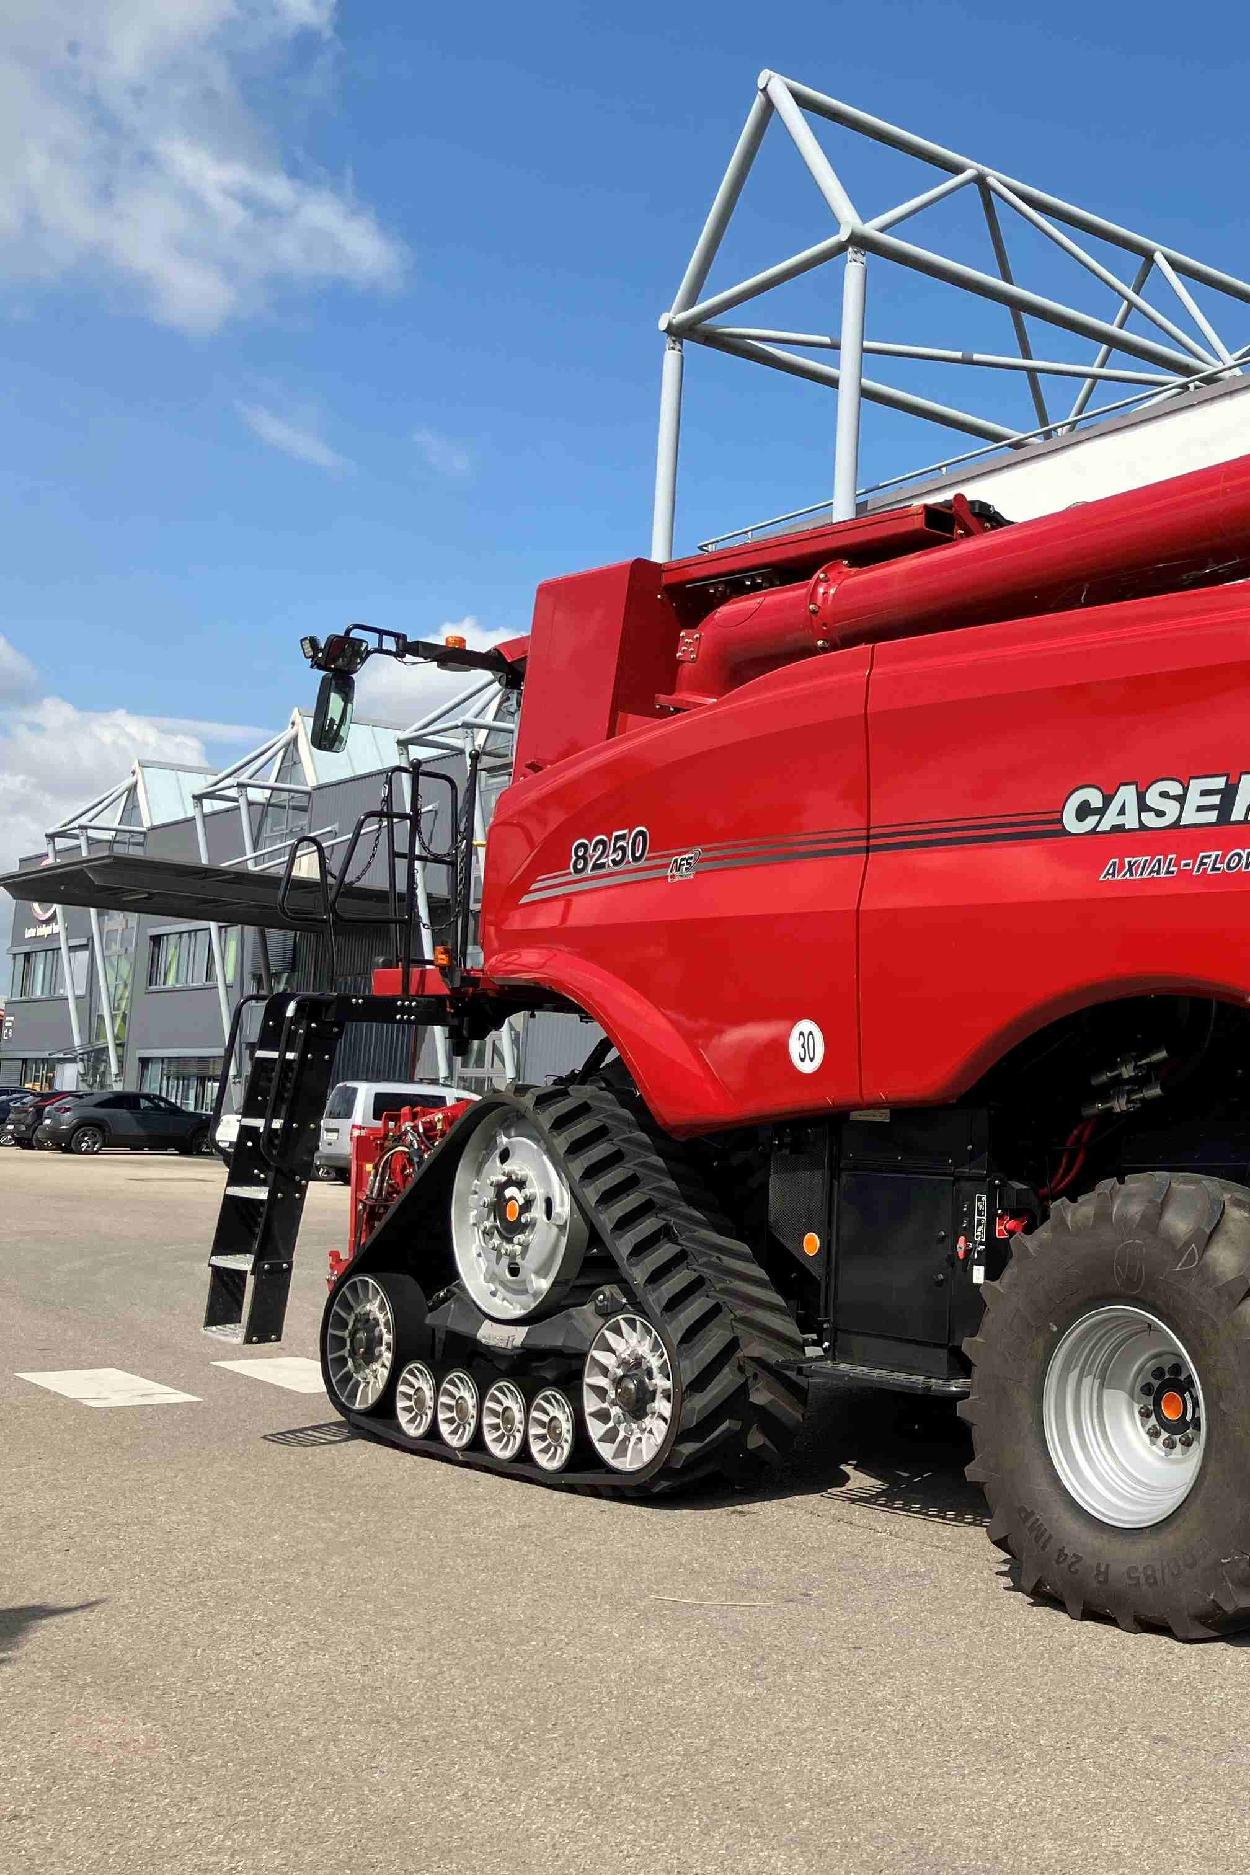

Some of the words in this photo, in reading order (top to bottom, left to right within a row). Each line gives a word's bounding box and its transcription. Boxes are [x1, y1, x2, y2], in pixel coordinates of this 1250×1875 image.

[1062, 775, 1228, 834] CASE
[570, 826, 649, 876] 8250
[668, 853, 696, 876] AFS
[798, 1030, 816, 1063] 30
